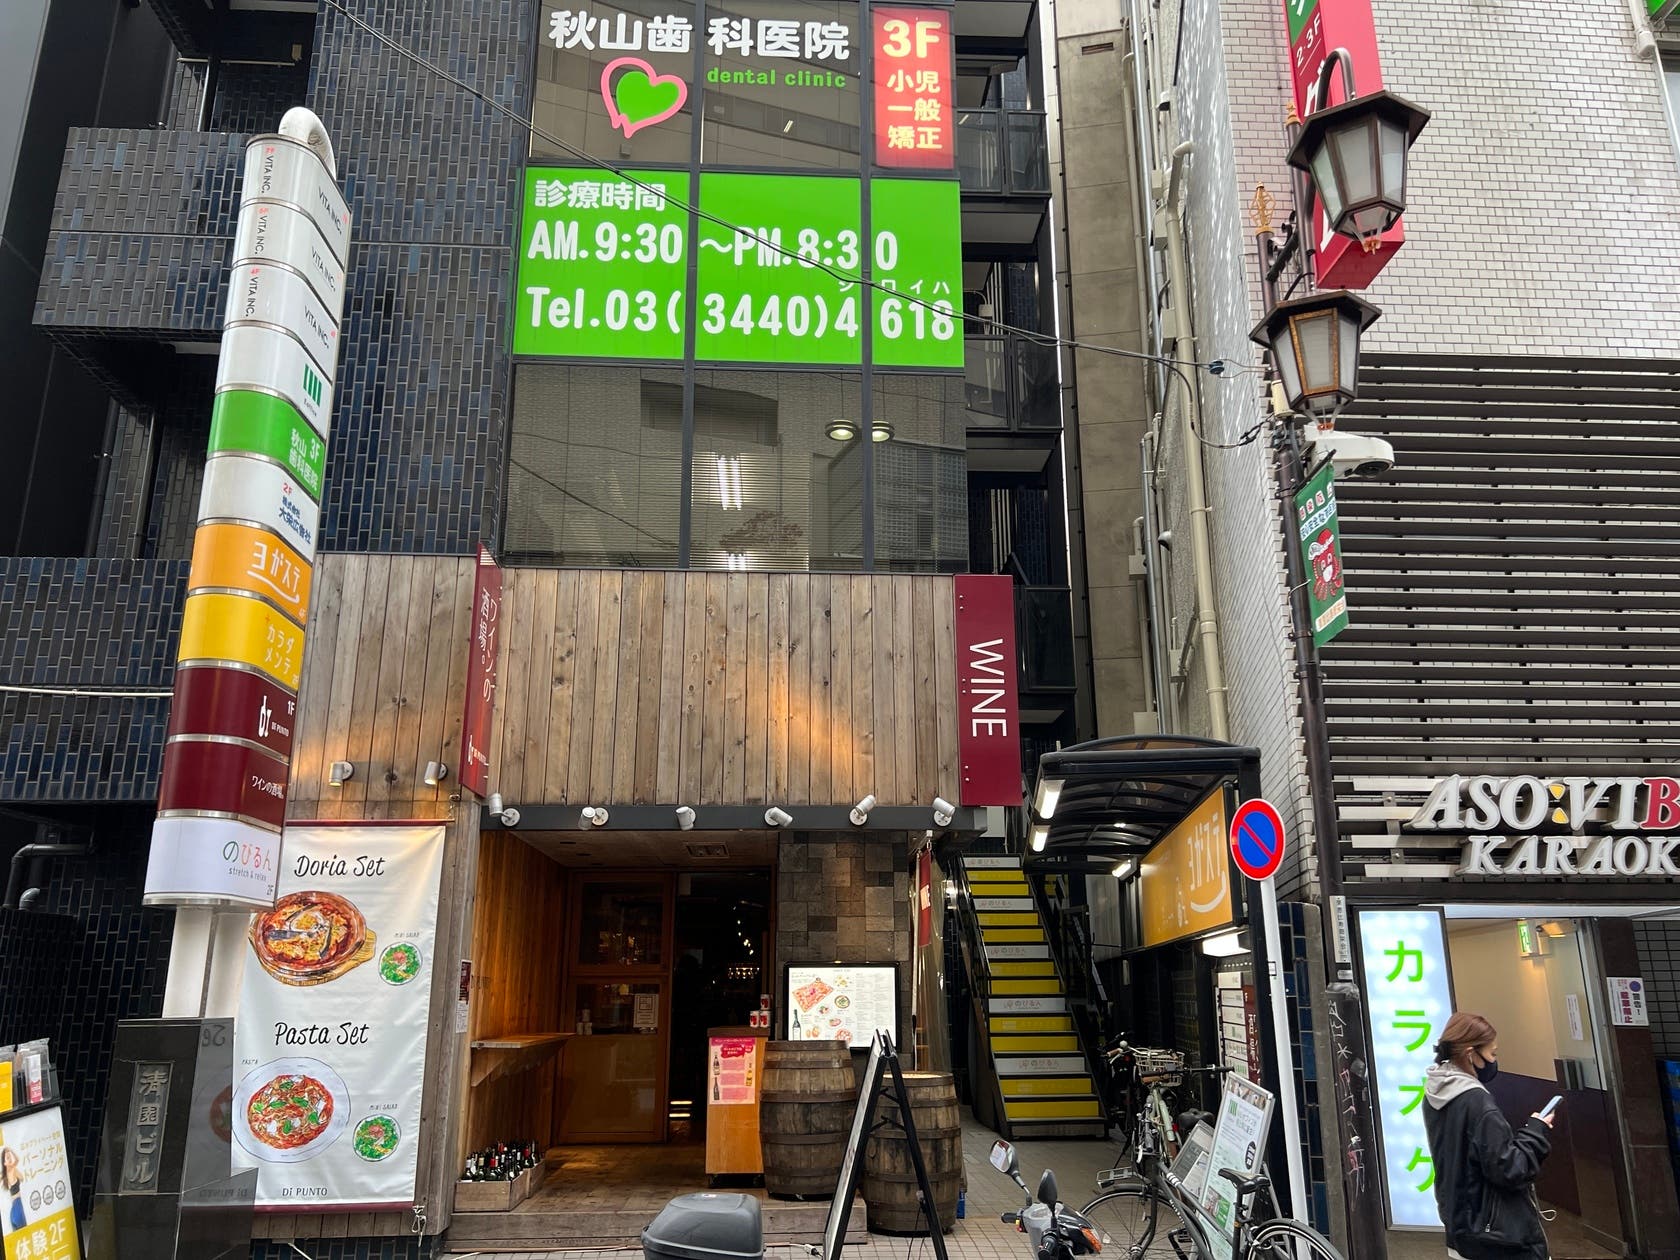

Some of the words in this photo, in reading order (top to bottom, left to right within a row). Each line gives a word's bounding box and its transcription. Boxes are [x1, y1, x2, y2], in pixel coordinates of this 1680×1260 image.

[882, 20, 942, 58] 3F
[706, 67, 777, 86] dental
[784, 70, 847, 88] clinic
[887, 70, 941, 95] 小児
[887, 98, 942, 122] 一般
[887, 126, 943, 151] 矯正
[264, 155, 274, 174] VITA
[534, 180, 666, 212] 診療時間
[257, 215, 268, 234] VITA
[248, 276, 259, 296] VITA
[310, 438, 321, 463] 3F
[283, 482, 293, 494] 2F
[267, 623, 295, 654] カラダ
[969, 638, 1008, 737] WINE
[288, 700, 296, 716] 1F
[223, 841, 272, 871] のびるん
[294, 855, 348, 879] Doria
[353, 854, 387, 878] Set
[274, 1022, 331, 1047] Pasta
[337, 1021, 370, 1047] Set
[296, 1186, 328, 1197] PUNTO
[49, 1218, 67, 1241] 2F
[15, 1231, 48, 1260] 体験
